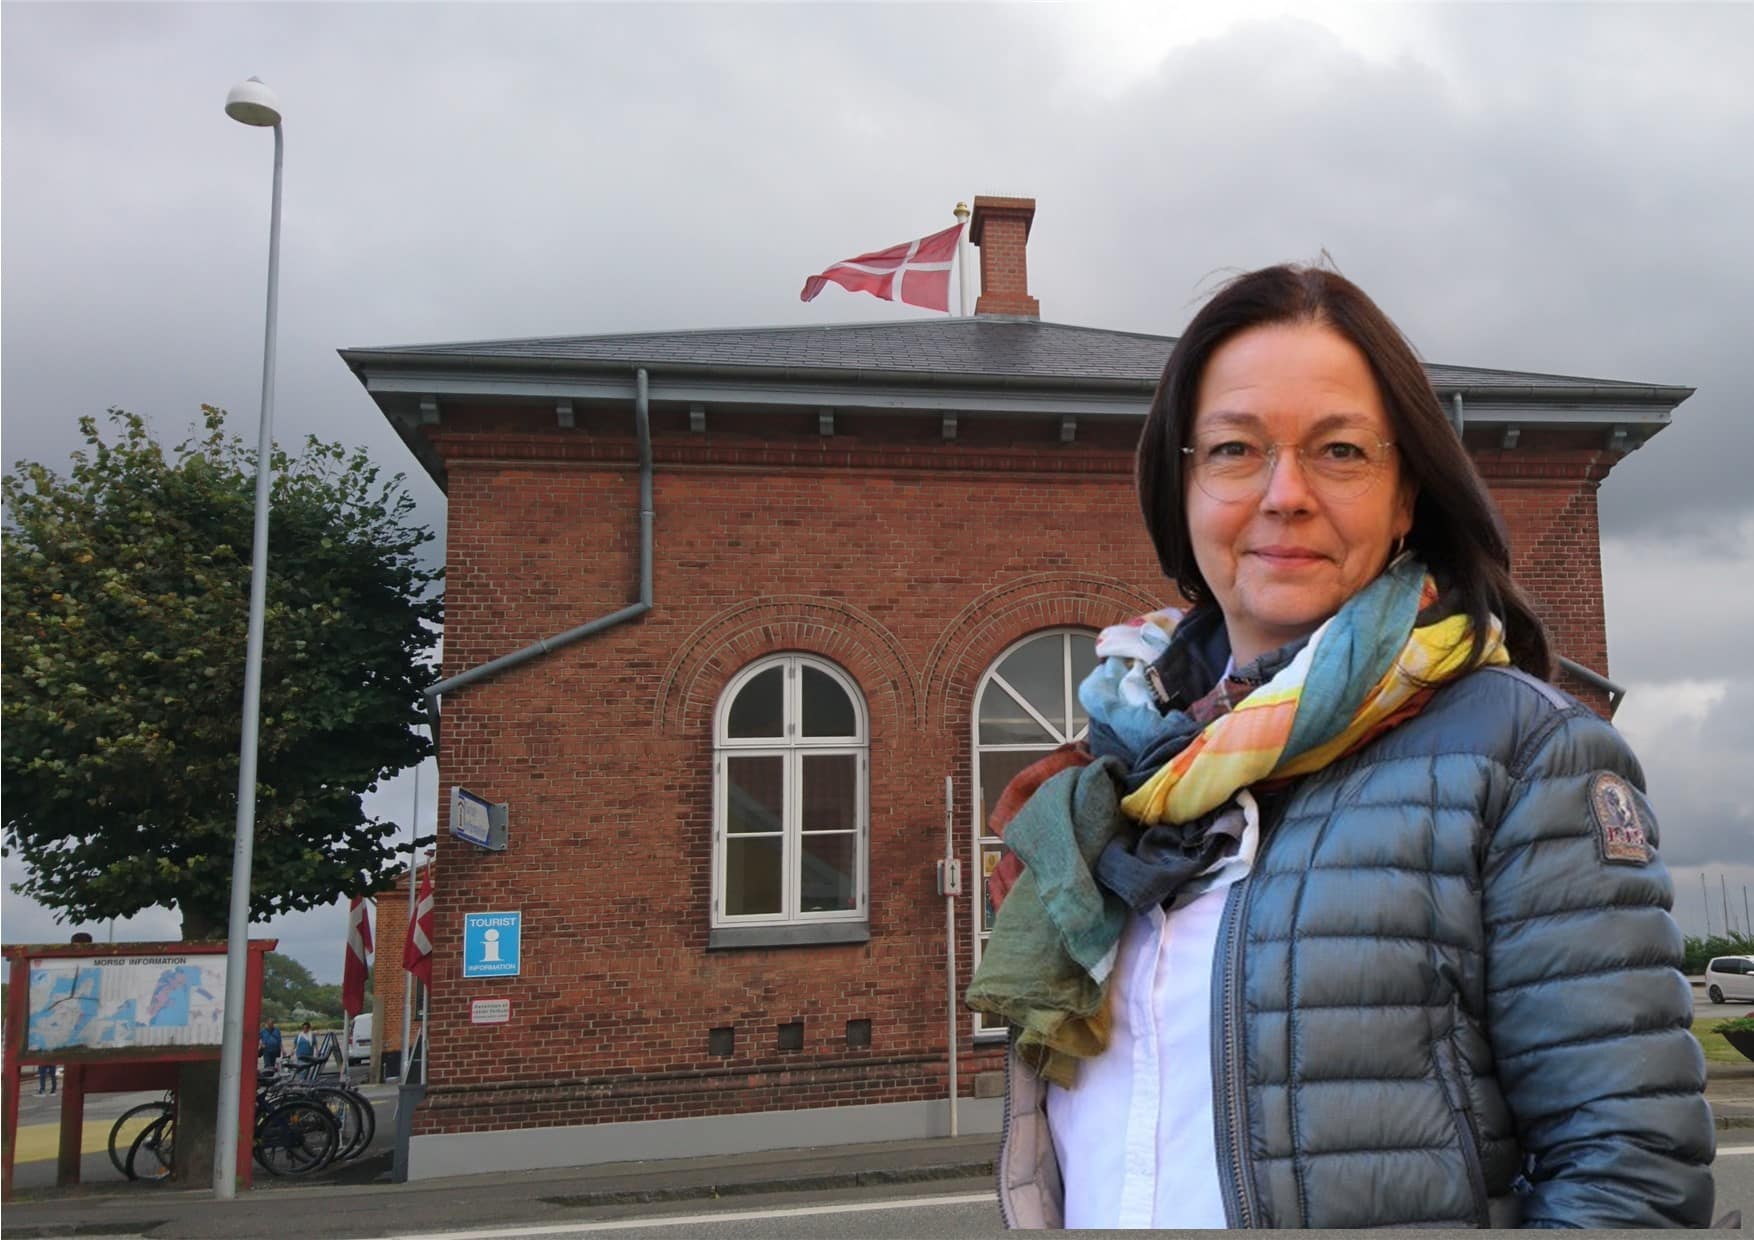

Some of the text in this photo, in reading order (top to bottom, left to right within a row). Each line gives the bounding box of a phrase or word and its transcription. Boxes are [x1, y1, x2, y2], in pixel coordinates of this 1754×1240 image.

[470, 917, 517, 927] TOURIST
[128, 957, 186, 966] INFORMATION
[468, 963, 516, 971] INFORMATION
